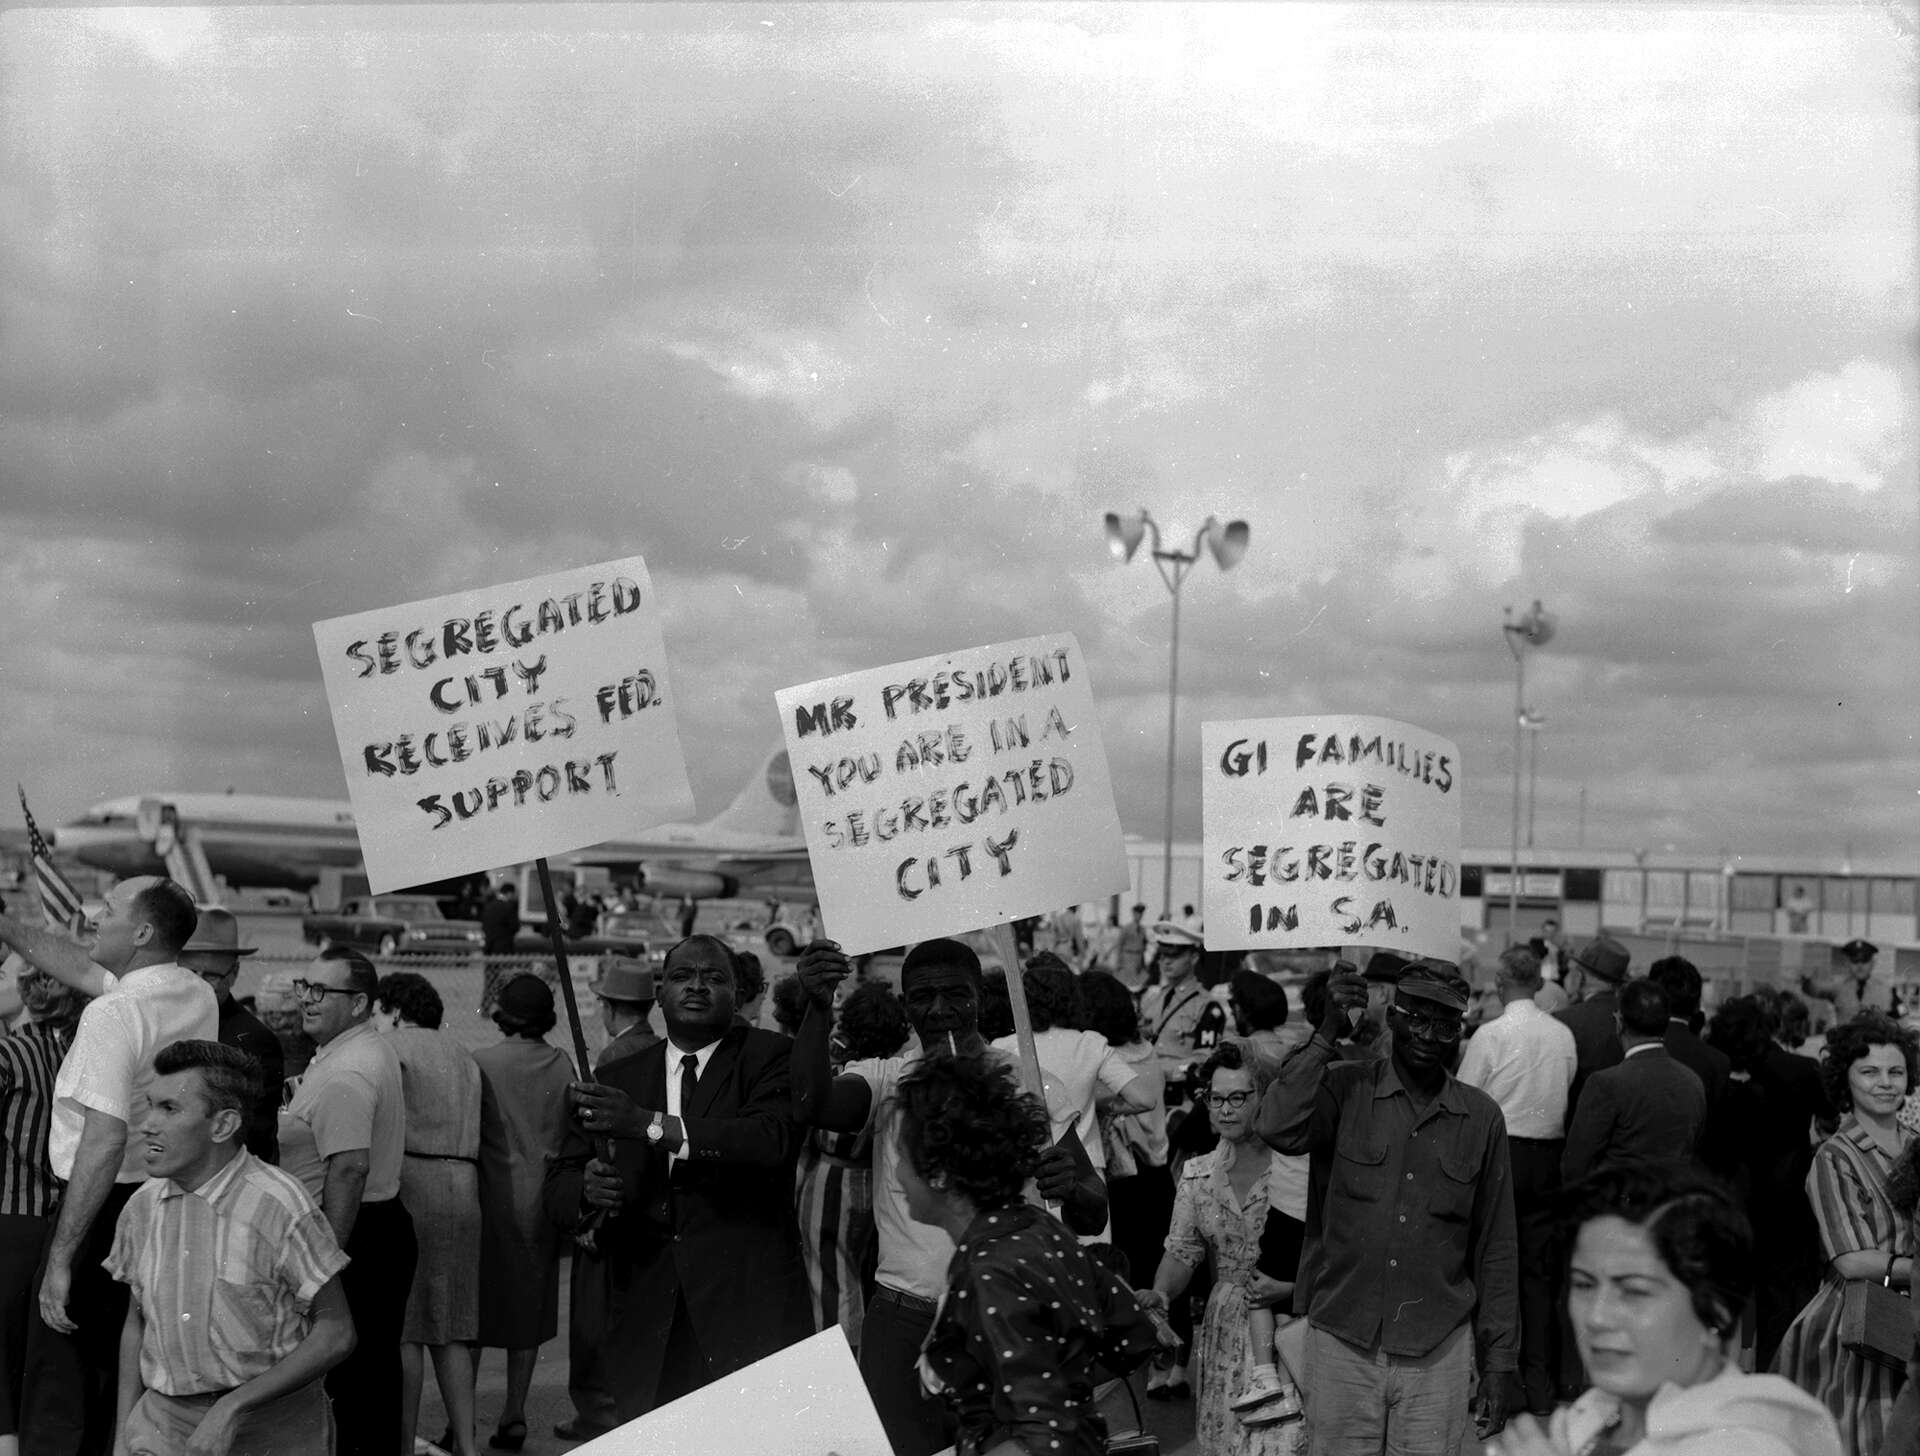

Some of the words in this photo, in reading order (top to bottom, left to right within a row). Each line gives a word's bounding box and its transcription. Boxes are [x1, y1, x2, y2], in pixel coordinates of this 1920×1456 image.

[345, 577, 641, 678] SEGREGATED
[429, 654, 547, 714] CITY
[881, 647, 1072, 720] PRESIDENT
[363, 697, 577, 778] RECEIVES
[596, 668, 662, 724] FED.
[808, 751, 882, 797] YOU
[896, 723, 973, 774] ARE
[990, 713, 1031, 754] IN
[1039, 703, 1070, 742] A
[1220, 738, 1268, 778] GI
[1296, 733, 1453, 794] FAMILIES
[823, 757, 1075, 850] SEGREGATED
[1289, 782, 1386, 827] ARE
[896, 828, 1020, 901] CITY
[1221, 841, 1457, 898] SEGREGATED
[1249, 903, 1299, 935] IN
